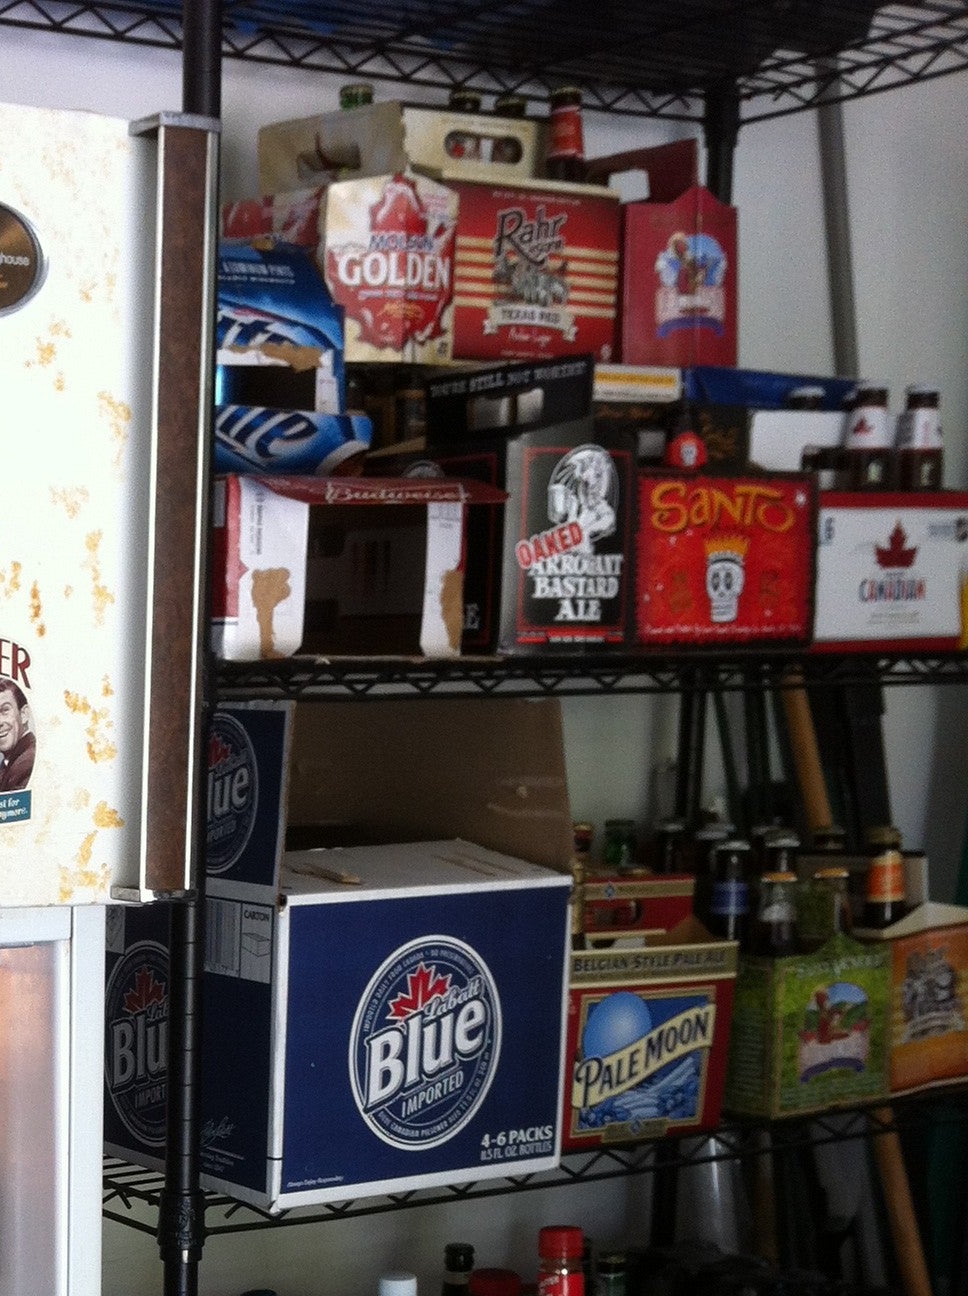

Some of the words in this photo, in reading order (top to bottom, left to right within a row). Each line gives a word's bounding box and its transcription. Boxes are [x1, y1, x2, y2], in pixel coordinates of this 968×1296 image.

[497, 206, 568, 264] Rahr
[337, 252, 452, 288] GOLDEN
[651, 481, 796, 534] SANTO
[554, 599, 602, 621] ALE
[7, 797, 20, 809] for
[244, 909, 271, 922] CARTON
[421, 974, 487, 1023] Labatt
[111, 1014, 169, 1090] Blu
[368, 996, 487, 1105] Blue
[574, 1046, 642, 1109] PALE
[647, 1012, 711, 1059] MOON
[401, 1069, 465, 1119] IMPORTED
[480, 1130, 507, 1149] 4-6
[509, 1124, 554, 1146] PACKS
